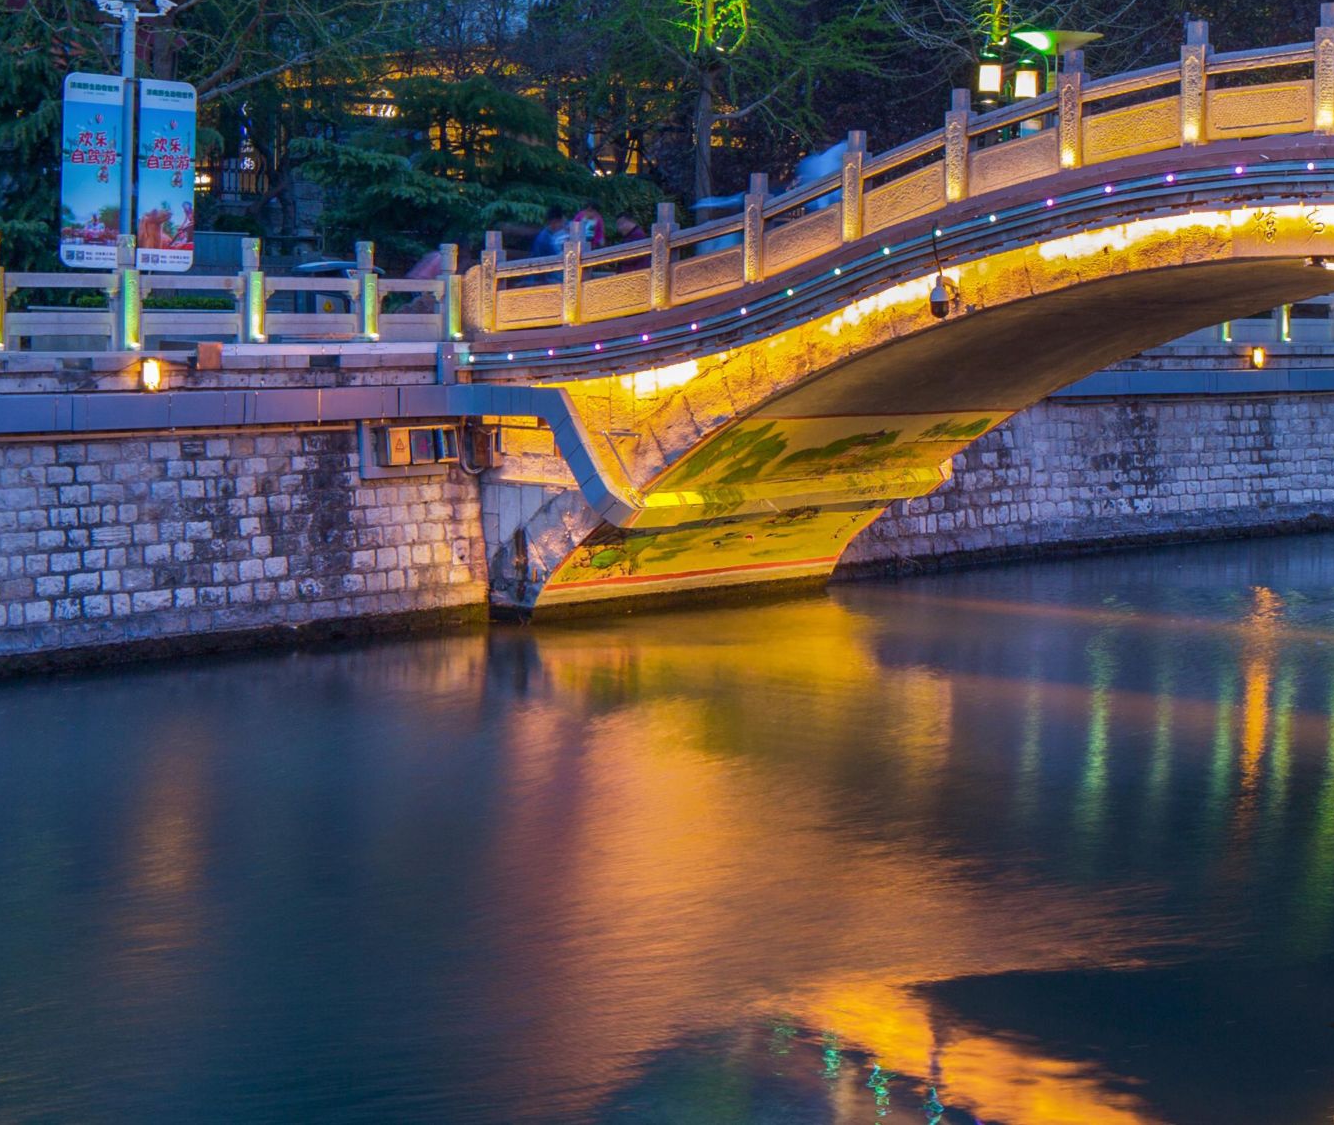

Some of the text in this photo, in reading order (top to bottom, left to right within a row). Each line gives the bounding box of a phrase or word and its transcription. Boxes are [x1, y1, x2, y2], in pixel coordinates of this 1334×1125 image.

[78, 131, 107, 147] 欢乐
[154, 137, 181, 153] 欢乐
[71, 148, 117, 165] 自驾游
[147, 154, 190, 171] 自驾游
